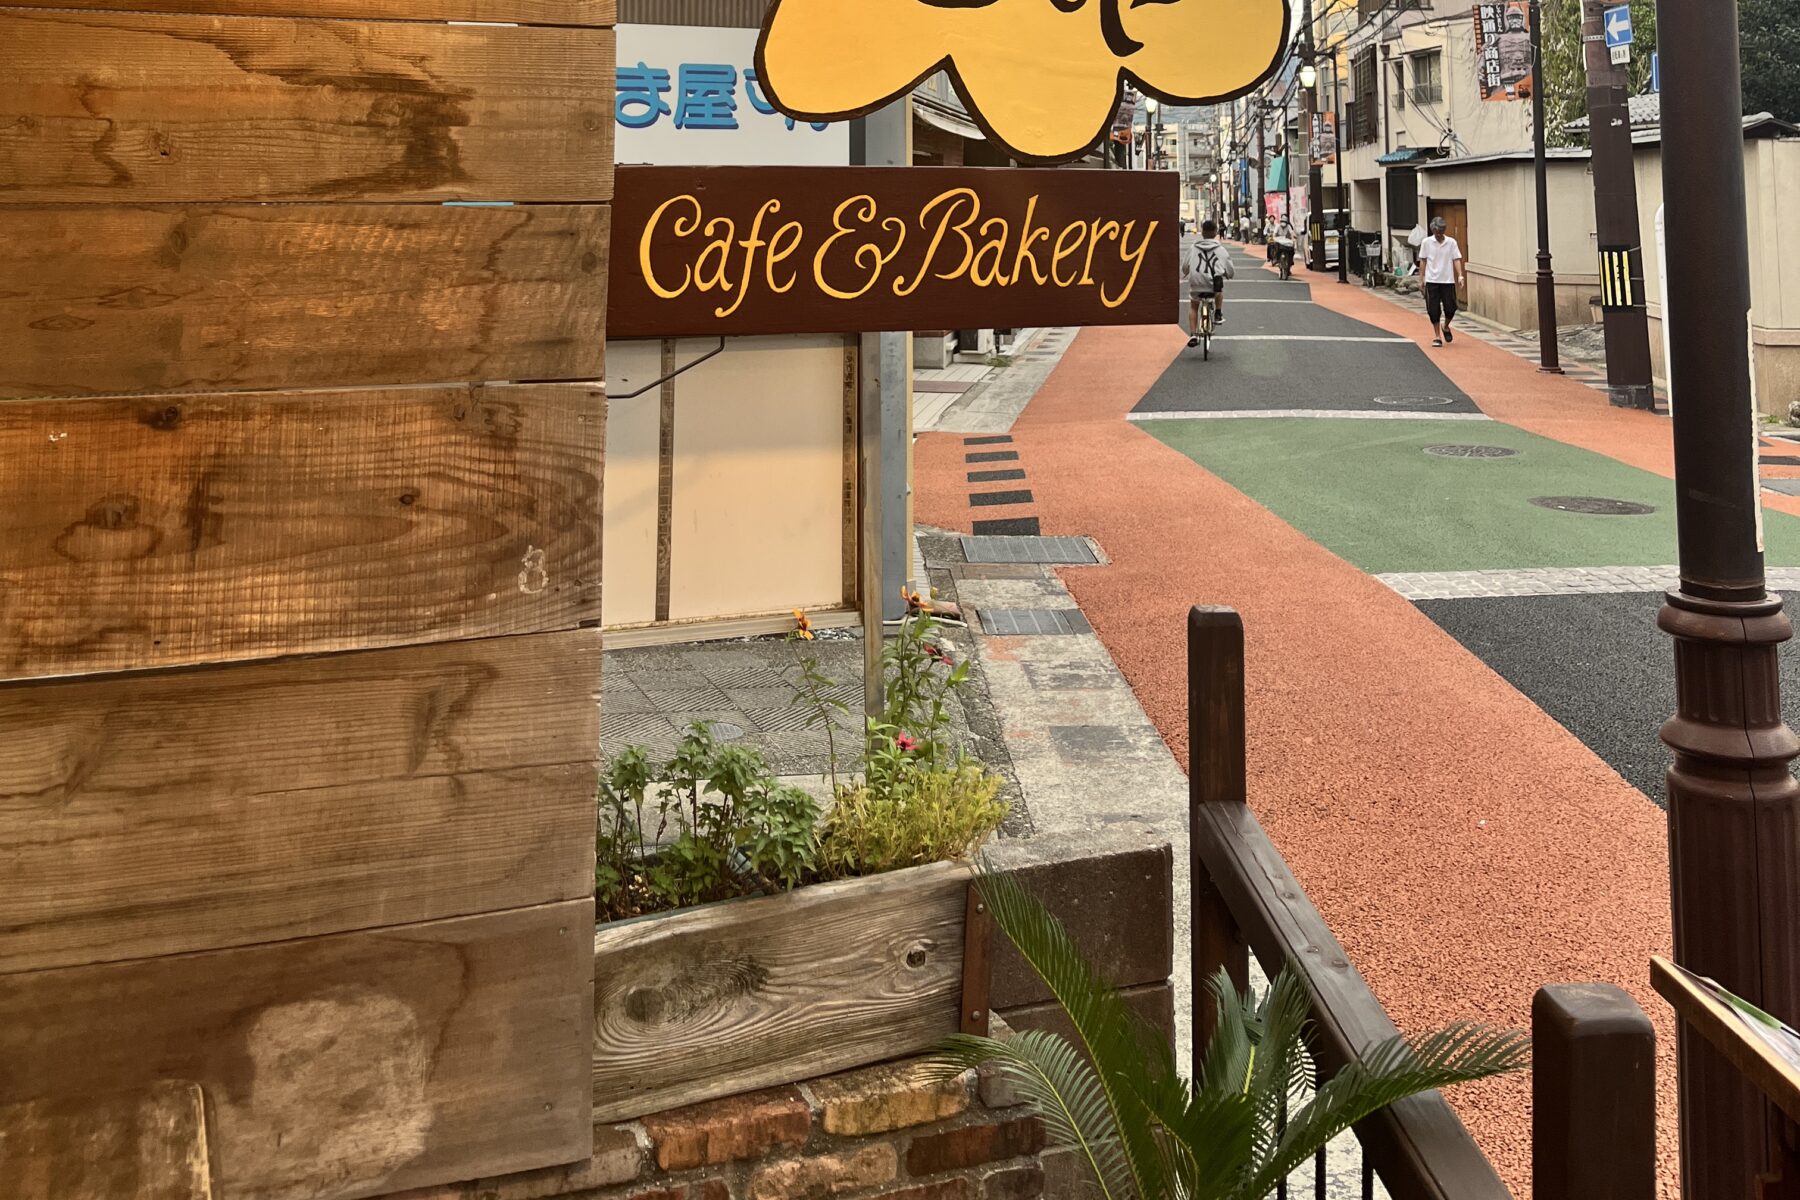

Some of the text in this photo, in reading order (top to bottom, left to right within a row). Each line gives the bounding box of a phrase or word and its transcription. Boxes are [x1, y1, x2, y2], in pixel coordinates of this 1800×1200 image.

[1480, 6, 1501, 87] 映通り商店街
[639, 187, 1159, 317] Cafe & Bakery
